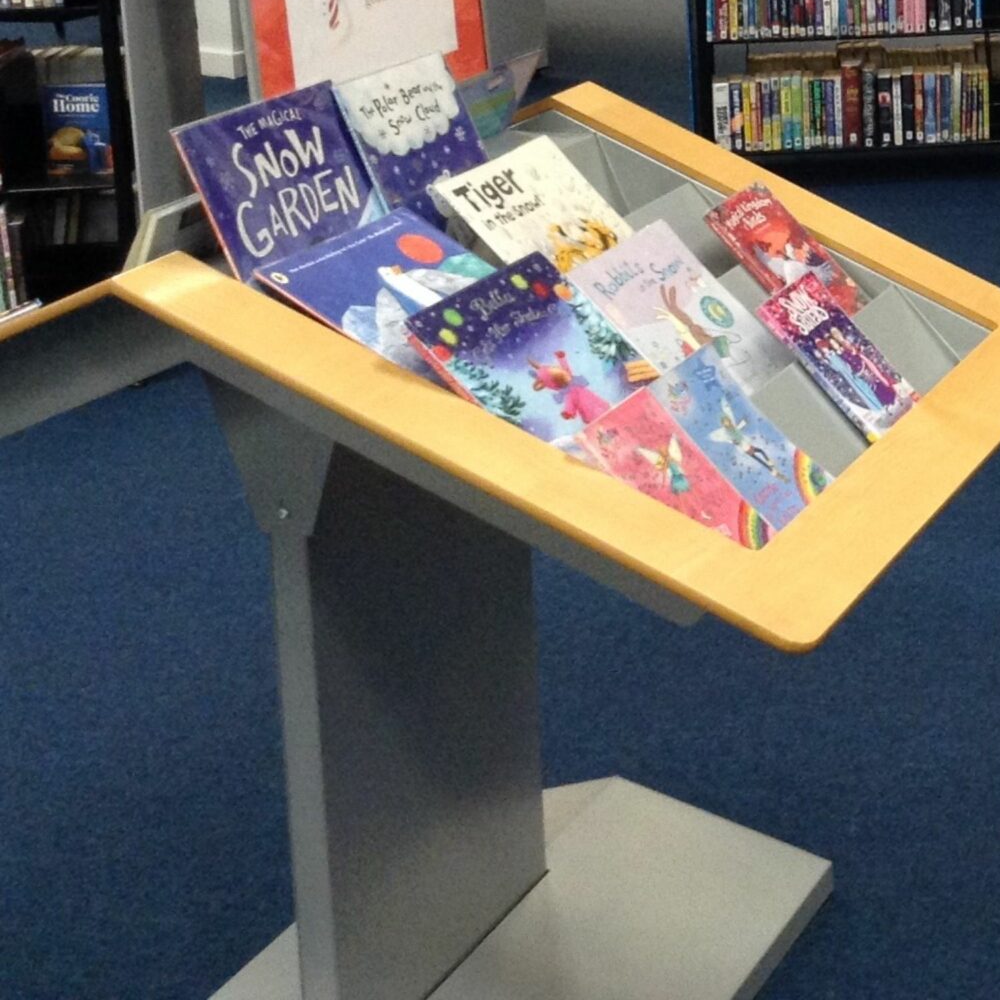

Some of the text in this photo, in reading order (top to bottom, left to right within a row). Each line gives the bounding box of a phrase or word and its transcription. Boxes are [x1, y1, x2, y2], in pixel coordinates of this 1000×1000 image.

[53, 99, 100, 113] Home
[373, 95, 398, 118] Polar
[399, 84, 421, 105] Bear
[388, 98, 441, 136] Snow Cloud
[236, 107, 303, 140] THE MAGICAL
[231, 125, 325, 198] SNOW
[452, 168, 524, 213] Tiger
[236, 165, 360, 258] GARDEN
[494, 211, 516, 225] the
[593, 260, 645, 302] Rabbits
